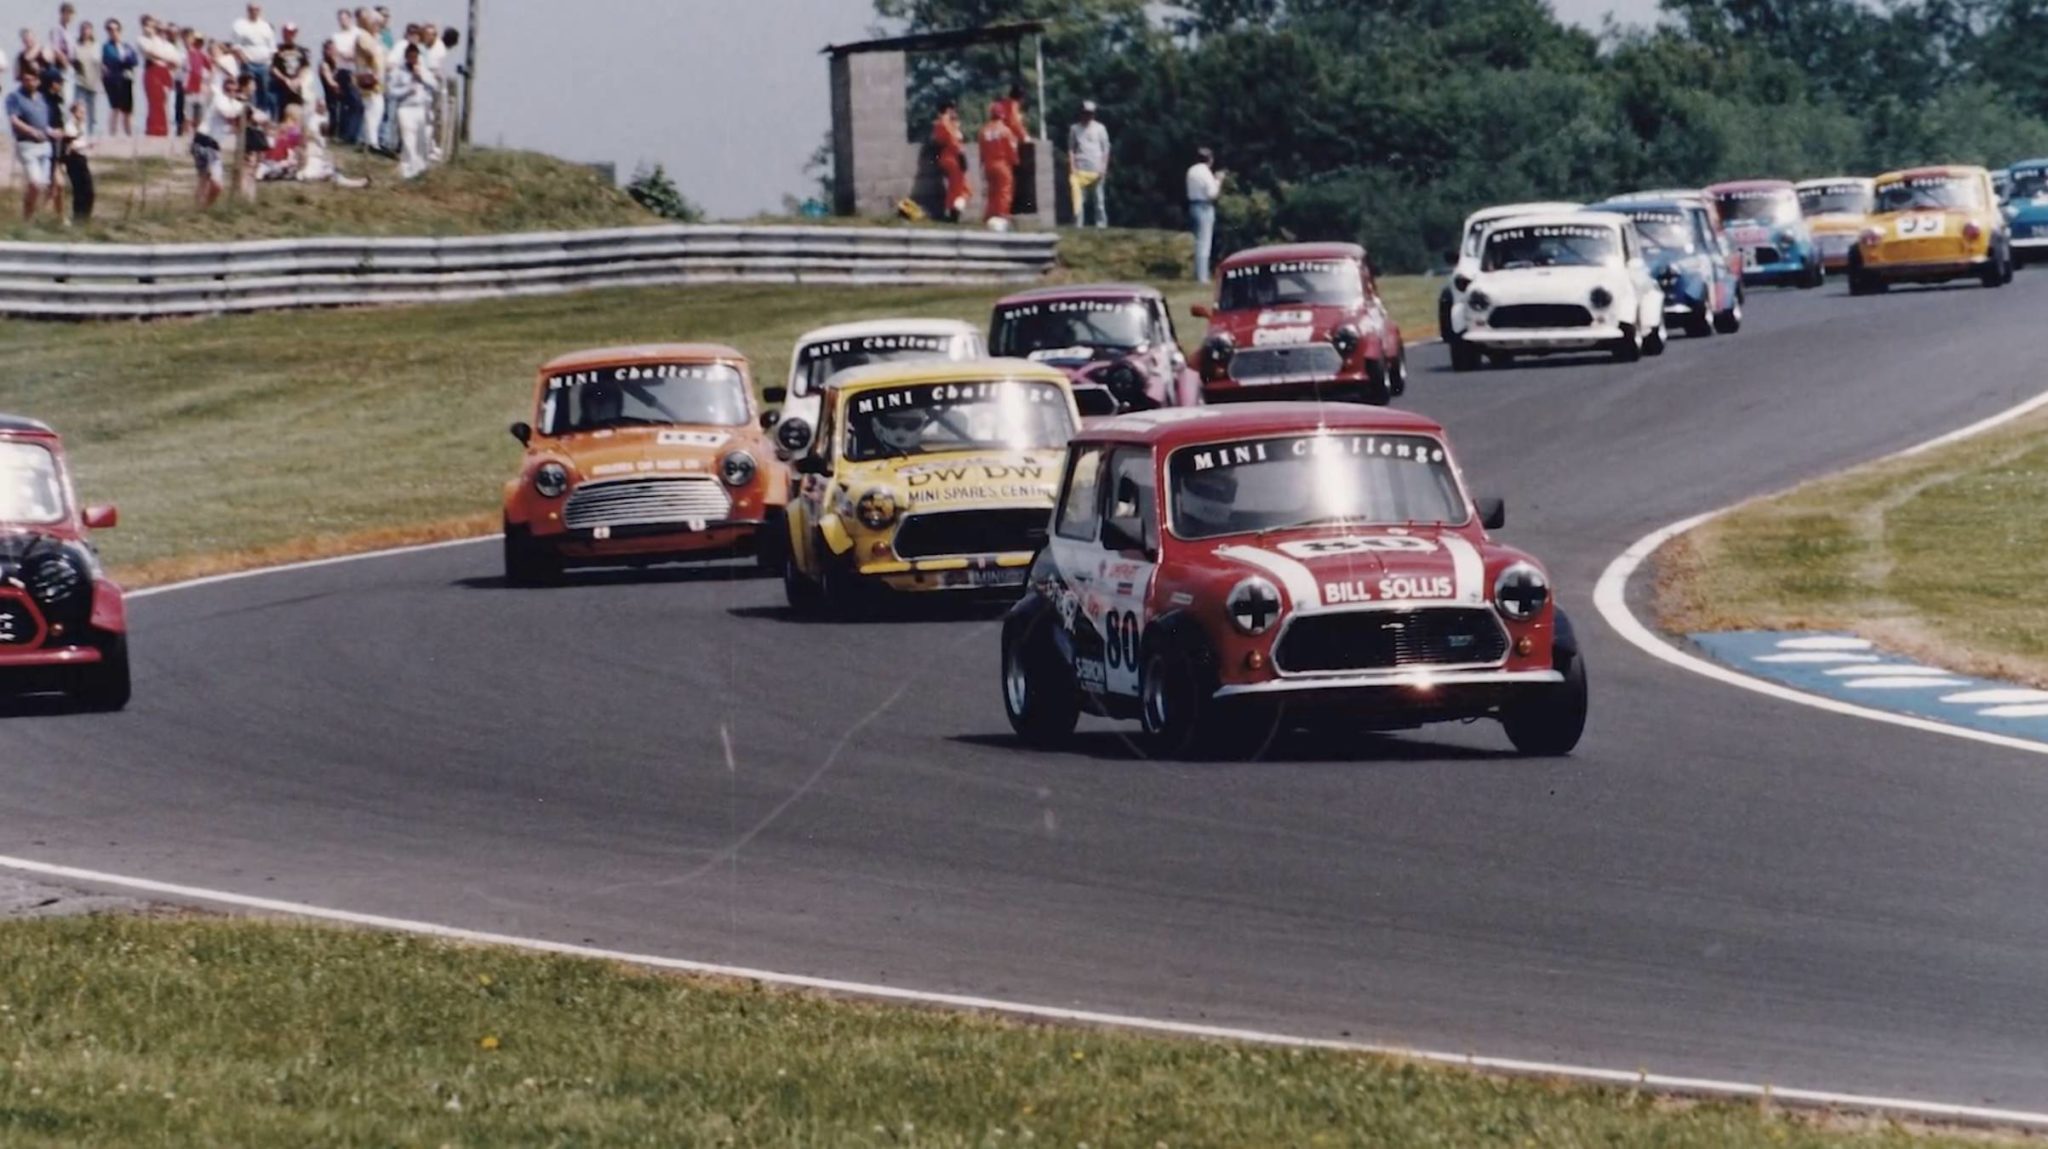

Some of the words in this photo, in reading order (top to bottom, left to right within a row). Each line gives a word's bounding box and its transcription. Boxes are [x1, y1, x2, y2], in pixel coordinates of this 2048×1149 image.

[862, 335, 950, 353] Challeng
[549, 371, 599, 390] MINI
[858, 390, 913, 414] MINI
[1193, 443, 1268, 471] MINI
[1291, 436, 1444, 464] Cllenge
[908, 487, 941, 503] MINI
[944, 485, 996, 501] SPARES
[1324, 580, 1372, 603] BILL
[1378, 575, 1453, 600] SOLLIS
[1105, 609, 1140, 673] 80
